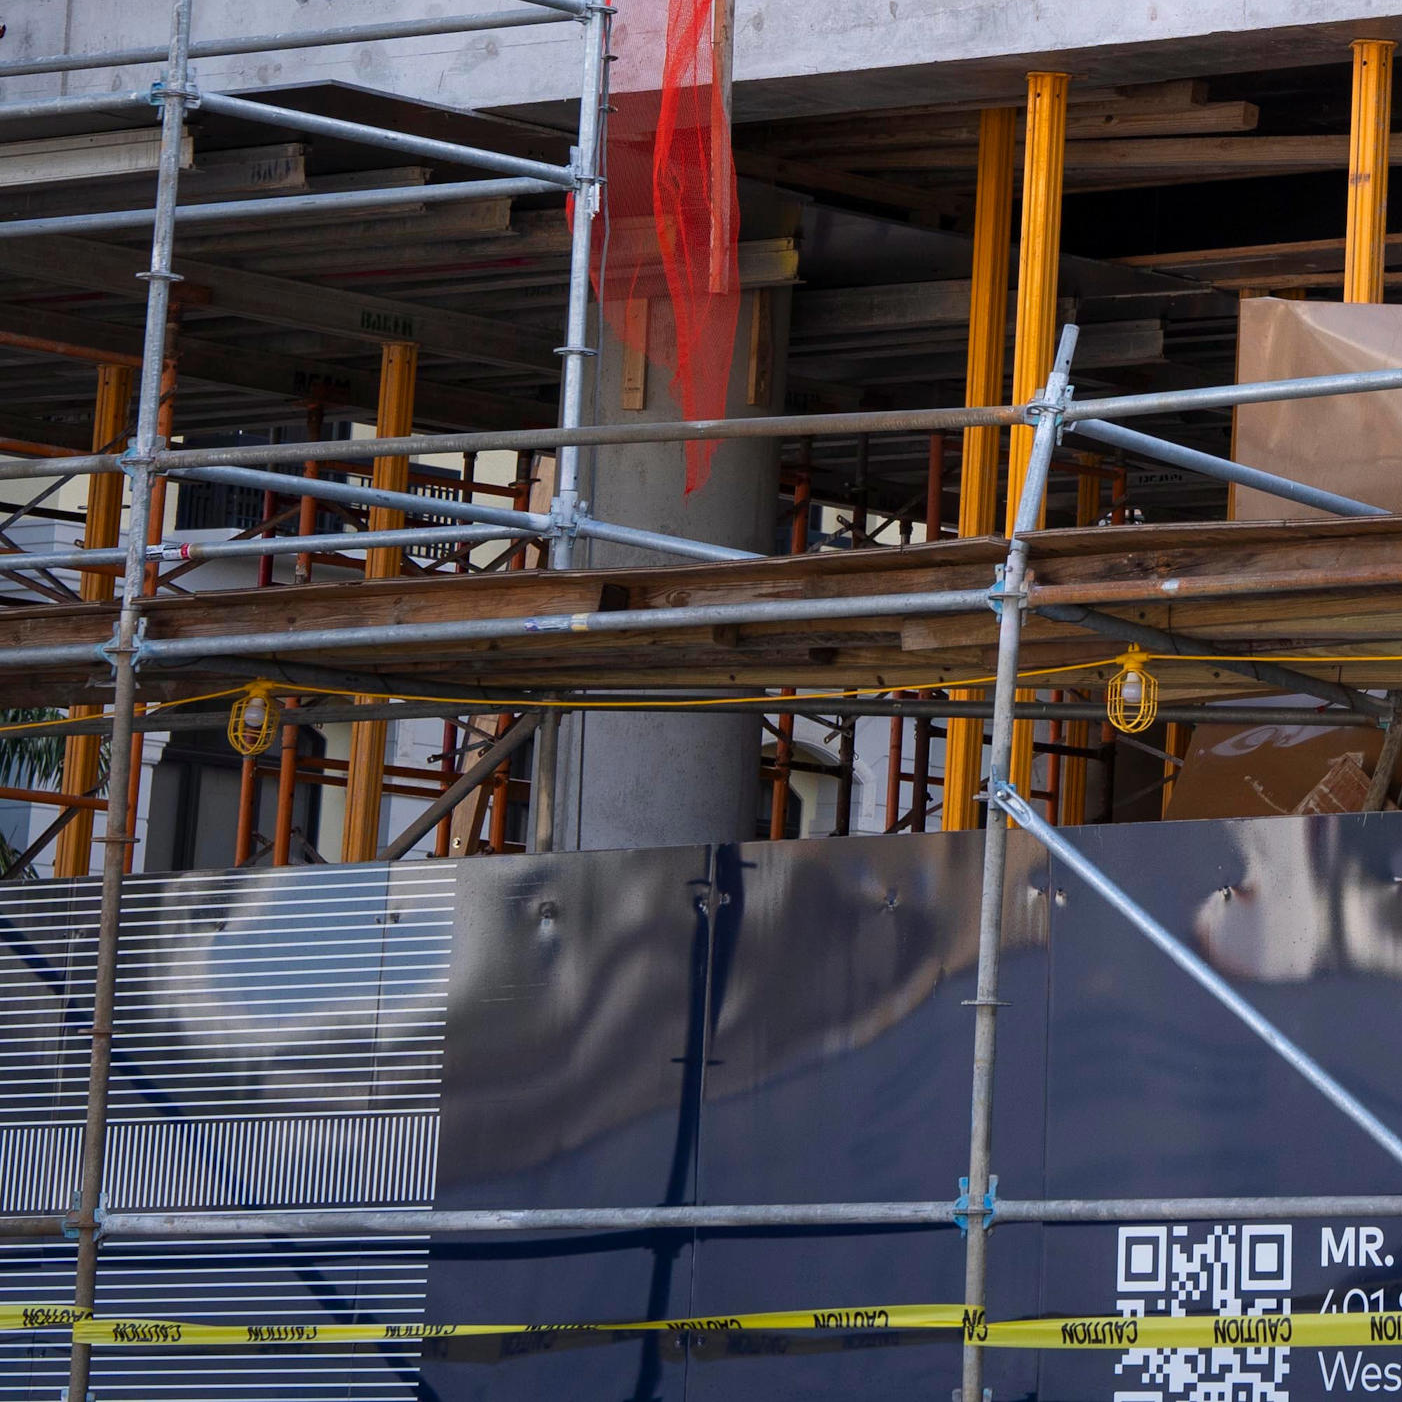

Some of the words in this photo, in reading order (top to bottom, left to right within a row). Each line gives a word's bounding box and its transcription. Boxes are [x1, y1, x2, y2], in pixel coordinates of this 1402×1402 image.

[1321, 1226, 1394, 1267] MR.
[1062, 1320, 1138, 1345] CAUTION
[1214, 1318, 1292, 1343] CAUTION
